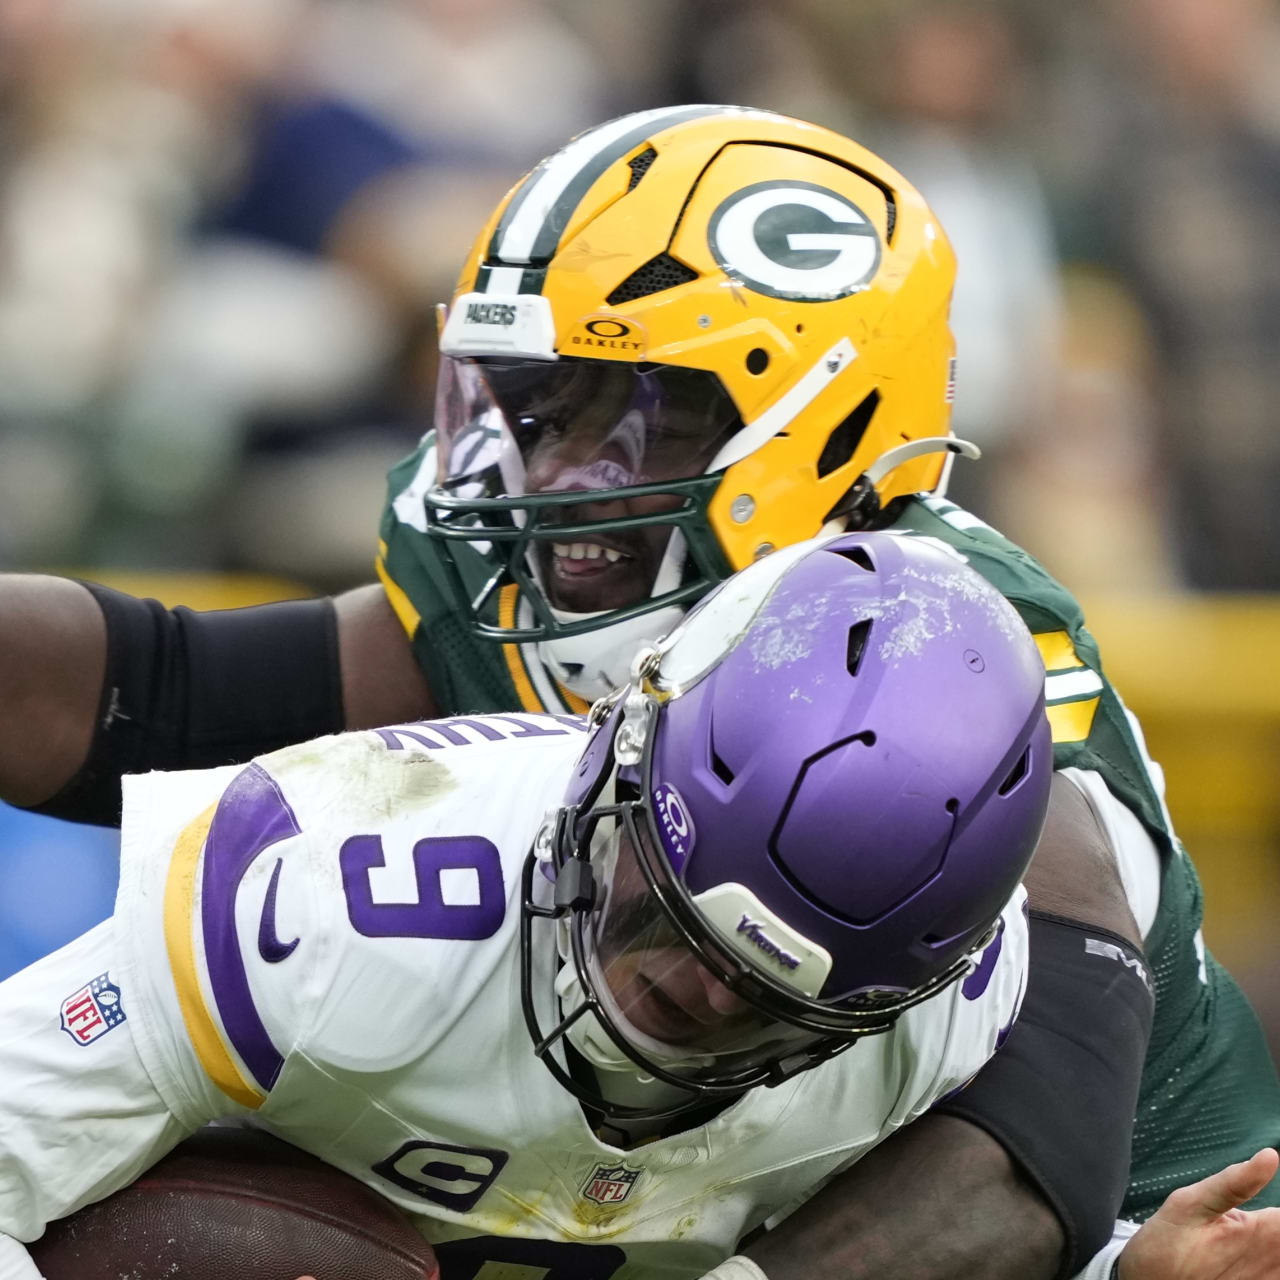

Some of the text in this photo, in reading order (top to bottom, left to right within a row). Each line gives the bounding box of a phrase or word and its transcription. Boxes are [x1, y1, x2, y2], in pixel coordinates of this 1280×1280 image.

[715, 187, 877, 299] G
[572, 336, 642, 350] OAKLEY
[655, 790, 685, 854] OAKLEY
[339, 835, 506, 941] 9
[65, 988, 102, 1041] NFL
[393, 1147, 494, 1195] C
[587, 1180, 624, 1201] NFL
